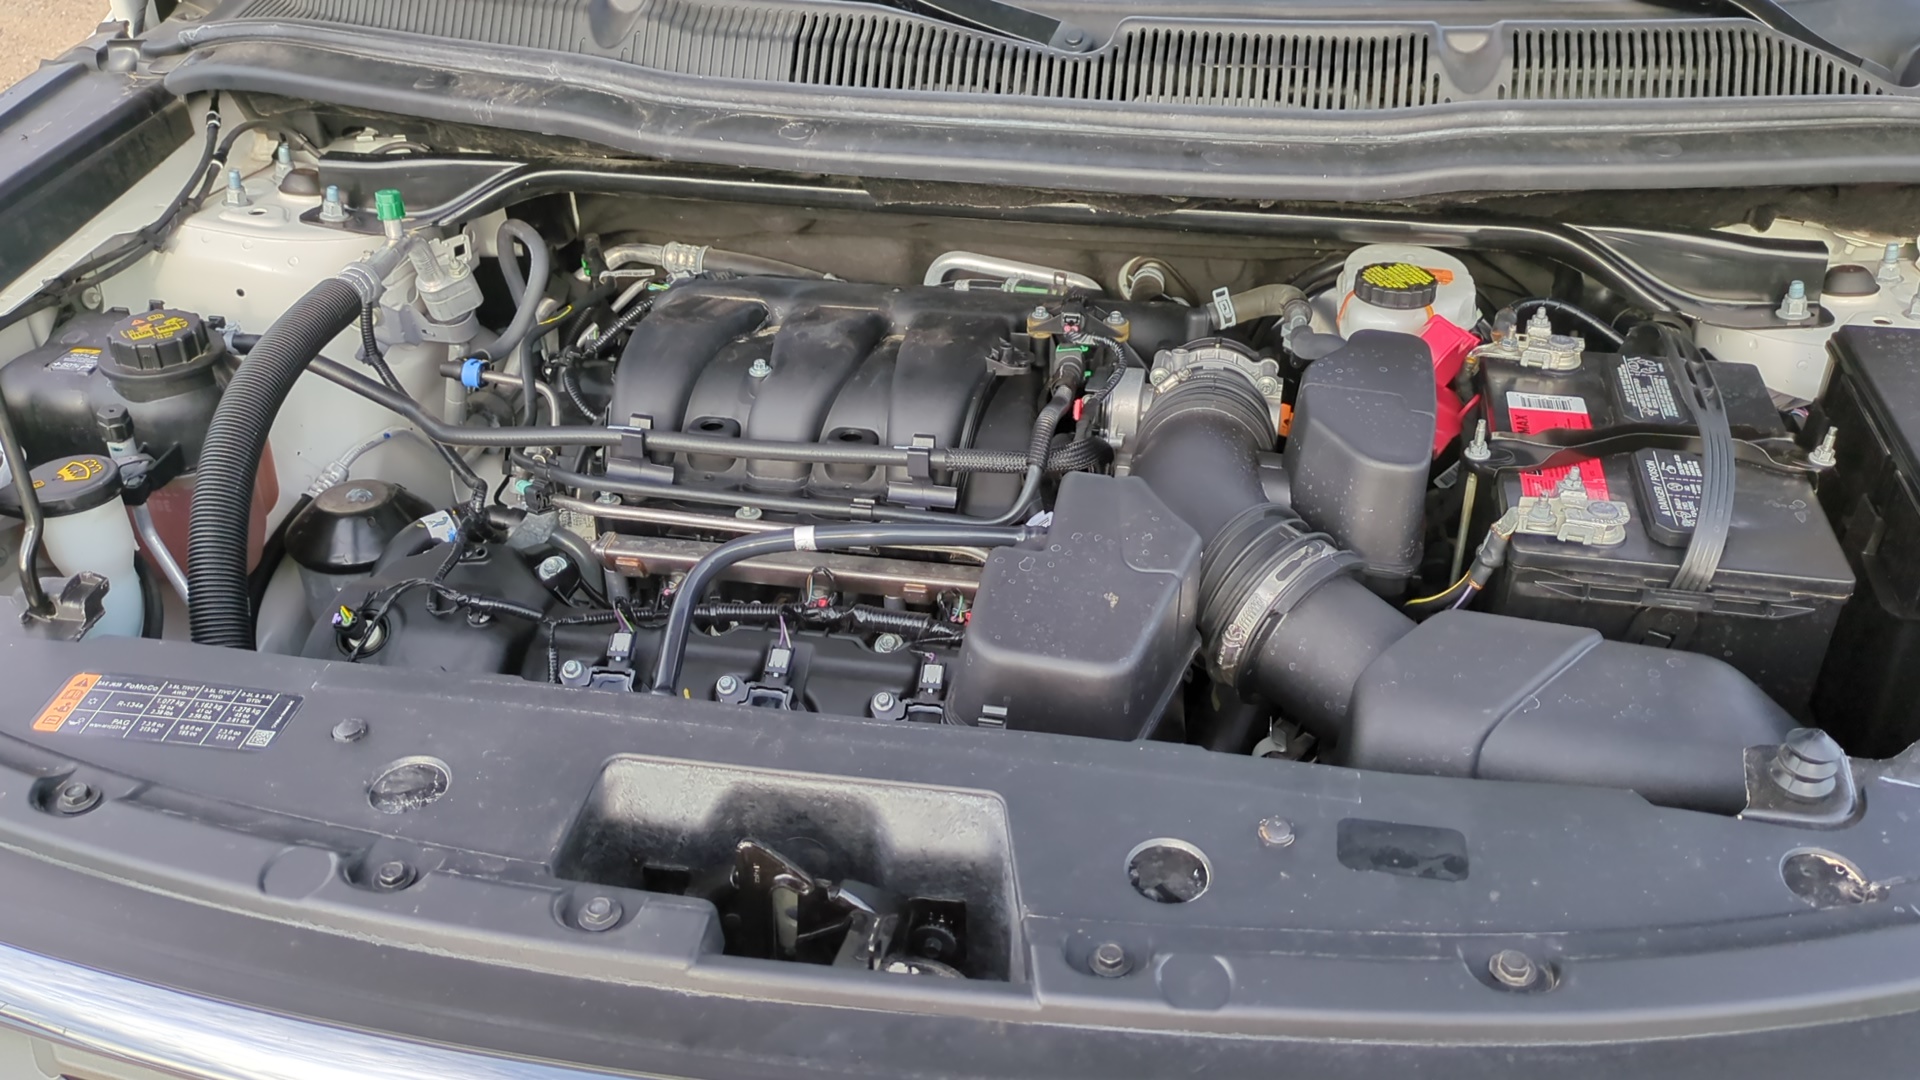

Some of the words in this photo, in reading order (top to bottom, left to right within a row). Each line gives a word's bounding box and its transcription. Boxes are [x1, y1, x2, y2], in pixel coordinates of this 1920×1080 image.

[1645, 459, 1660, 481] POISON
[1653, 486, 1669, 510] DANGER
[124, 682, 159, 691] FoMoCo
[117, 700, 144, 709] R-134a
[213, 703, 224, 711] kg
[232, 705, 250, 713] 1.276
[251, 707, 261, 716] kg
